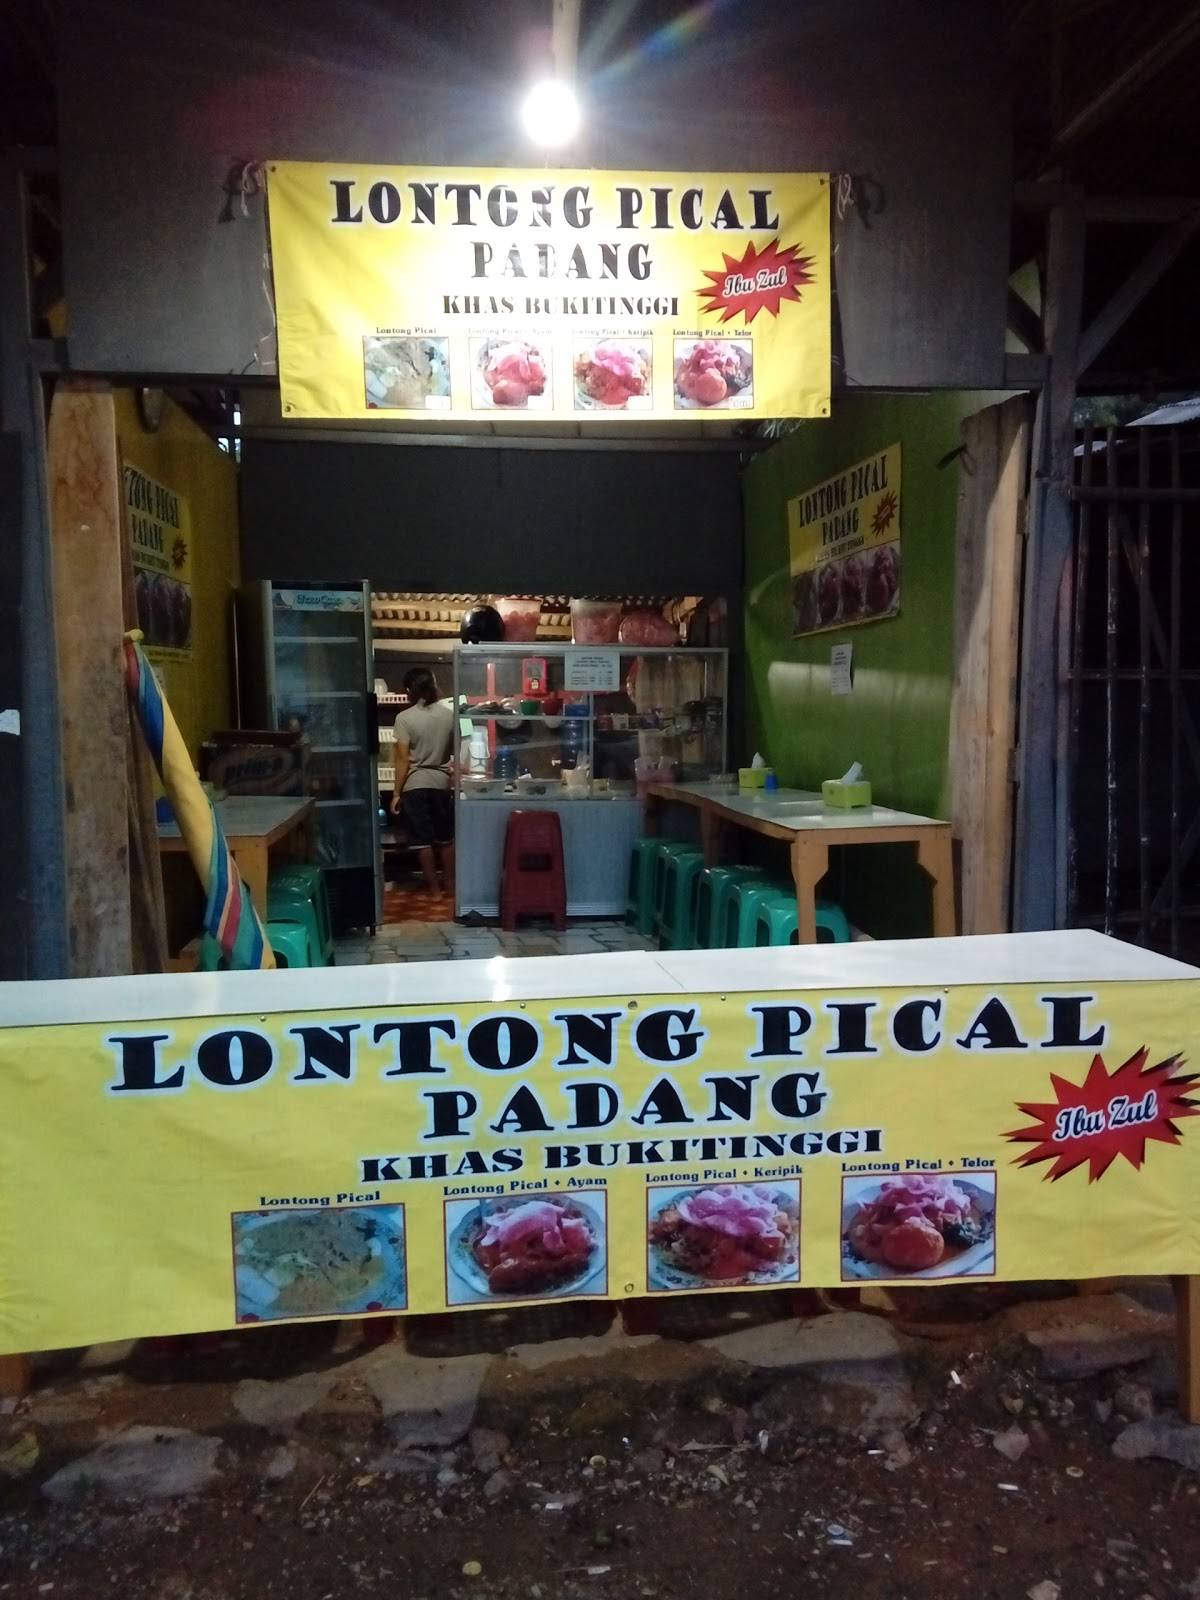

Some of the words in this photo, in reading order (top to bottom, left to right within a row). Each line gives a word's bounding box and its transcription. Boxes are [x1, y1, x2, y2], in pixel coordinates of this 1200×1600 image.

[329, 180, 593, 229] LONTONG
[615, 187, 780, 230] PICAL
[470, 241, 653, 281] PADANG
[442, 295, 514, 315] KHAS
[525, 297, 679, 316] BUKITINGGI
[376, 327, 412, 335] Lontong
[108, 1007, 705, 1091] LONTONG
[751, 996, 1106, 1058] PICAL
[423, 1072, 828, 1139] PADANG
[1053, 1109, 1104, 1139] Ibu
[1110, 1092, 1156, 1127] Zul
[361, 1148, 524, 1182] KHAS
[544, 1130, 882, 1168] BUKITINGGI
[841, 1162, 900, 1173] Lontong
[905, 1159, 942, 1170] Pical
[960, 1157, 996, 1168] Telor
[443, 1184, 505, 1196] Lontong
[510, 1179, 548, 1191] Pical
[566, 1177, 608, 1188] Ayam
[645, 1170, 699, 1184] Lontong
[703, 1168, 737, 1179] Pical
[754, 1164, 803, 1178] Keripik
[259, 1194, 331, 1206] Lontong
[336, 1191, 381, 1202] Pical
